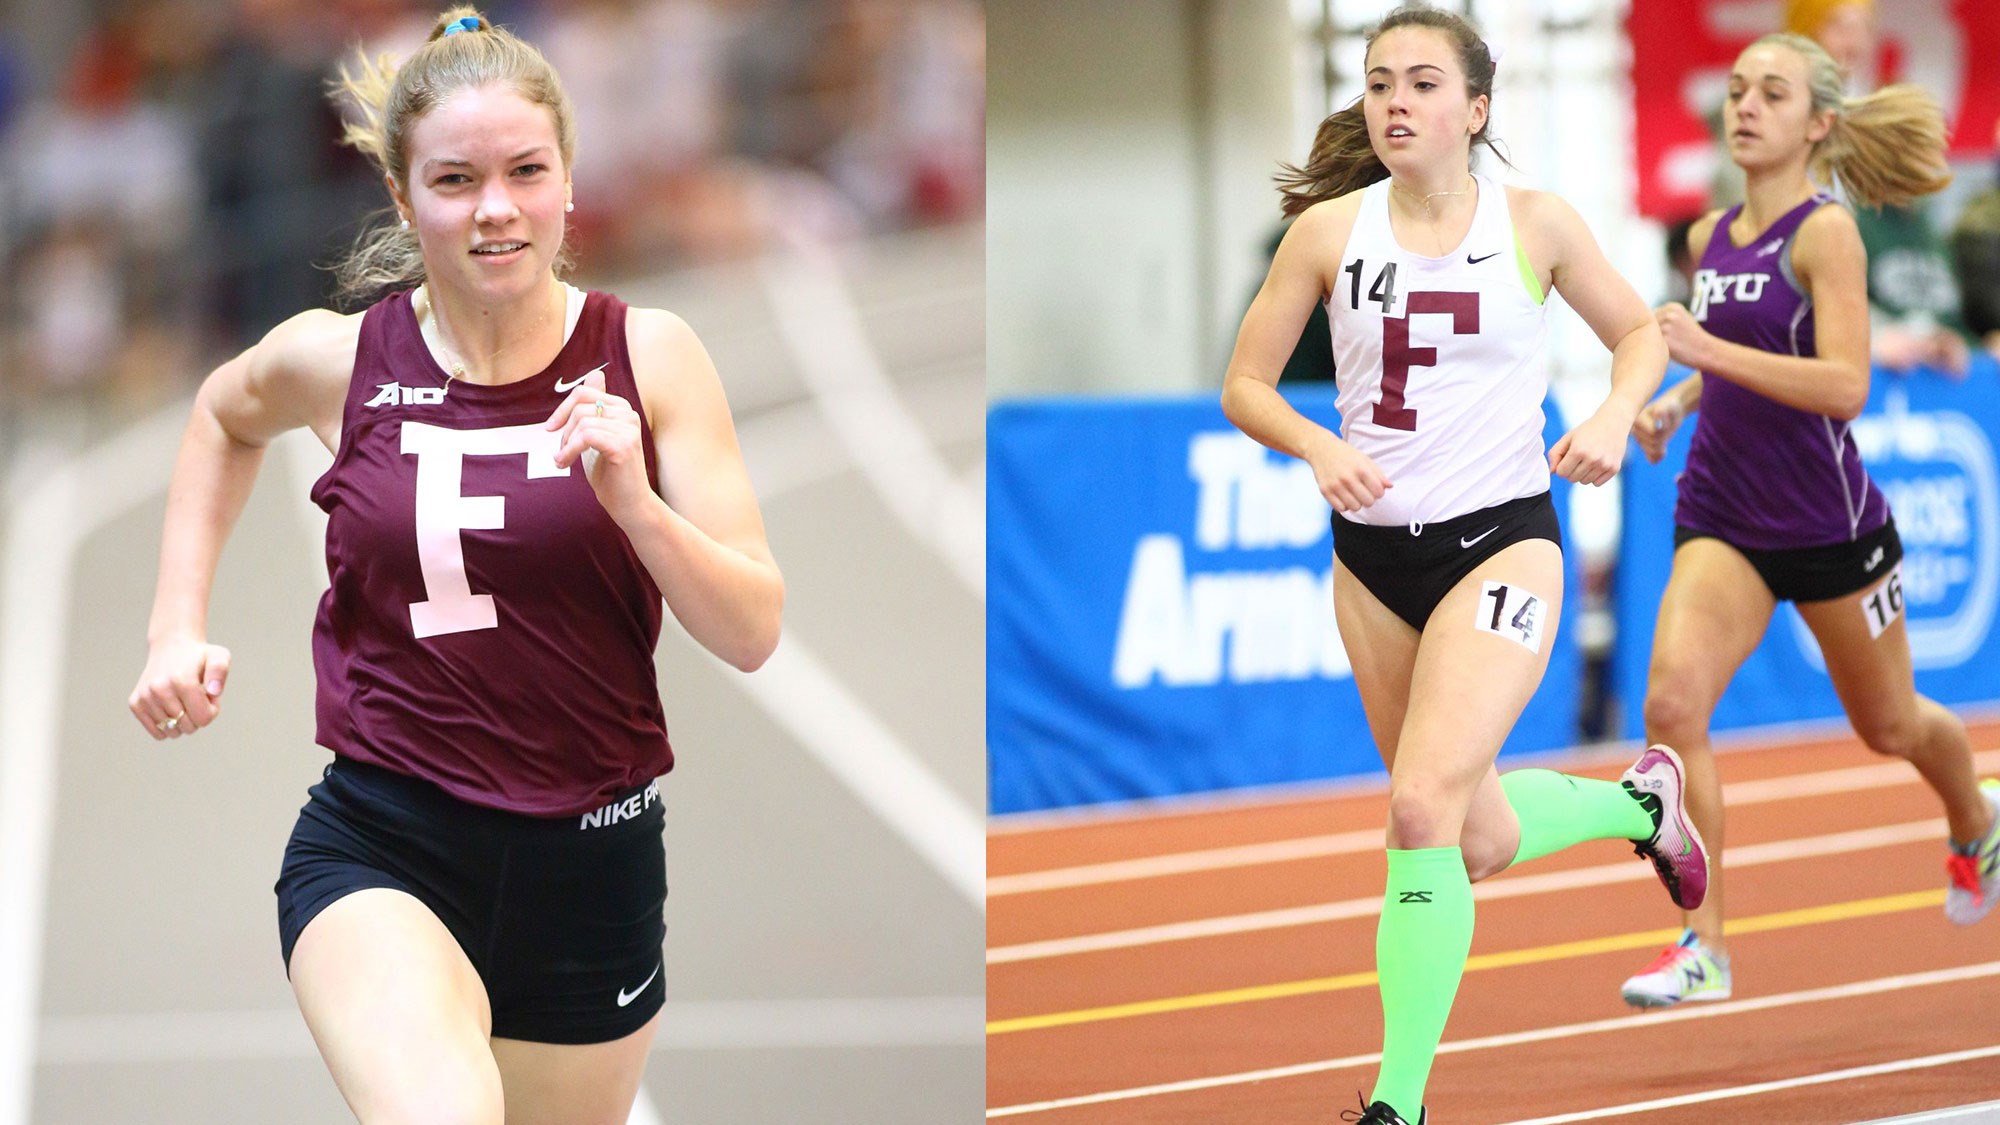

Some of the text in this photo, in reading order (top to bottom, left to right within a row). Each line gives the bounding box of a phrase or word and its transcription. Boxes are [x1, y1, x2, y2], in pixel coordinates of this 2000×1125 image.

[1345, 258, 1398, 313] 14
[1372, 291, 1480, 432] F
[363, 381, 446, 408] A10
[400, 421, 571, 639] F
[1487, 585, 1538, 642] 14
[1869, 574, 1902, 627] 16
[580, 793, 642, 830] NIKE
